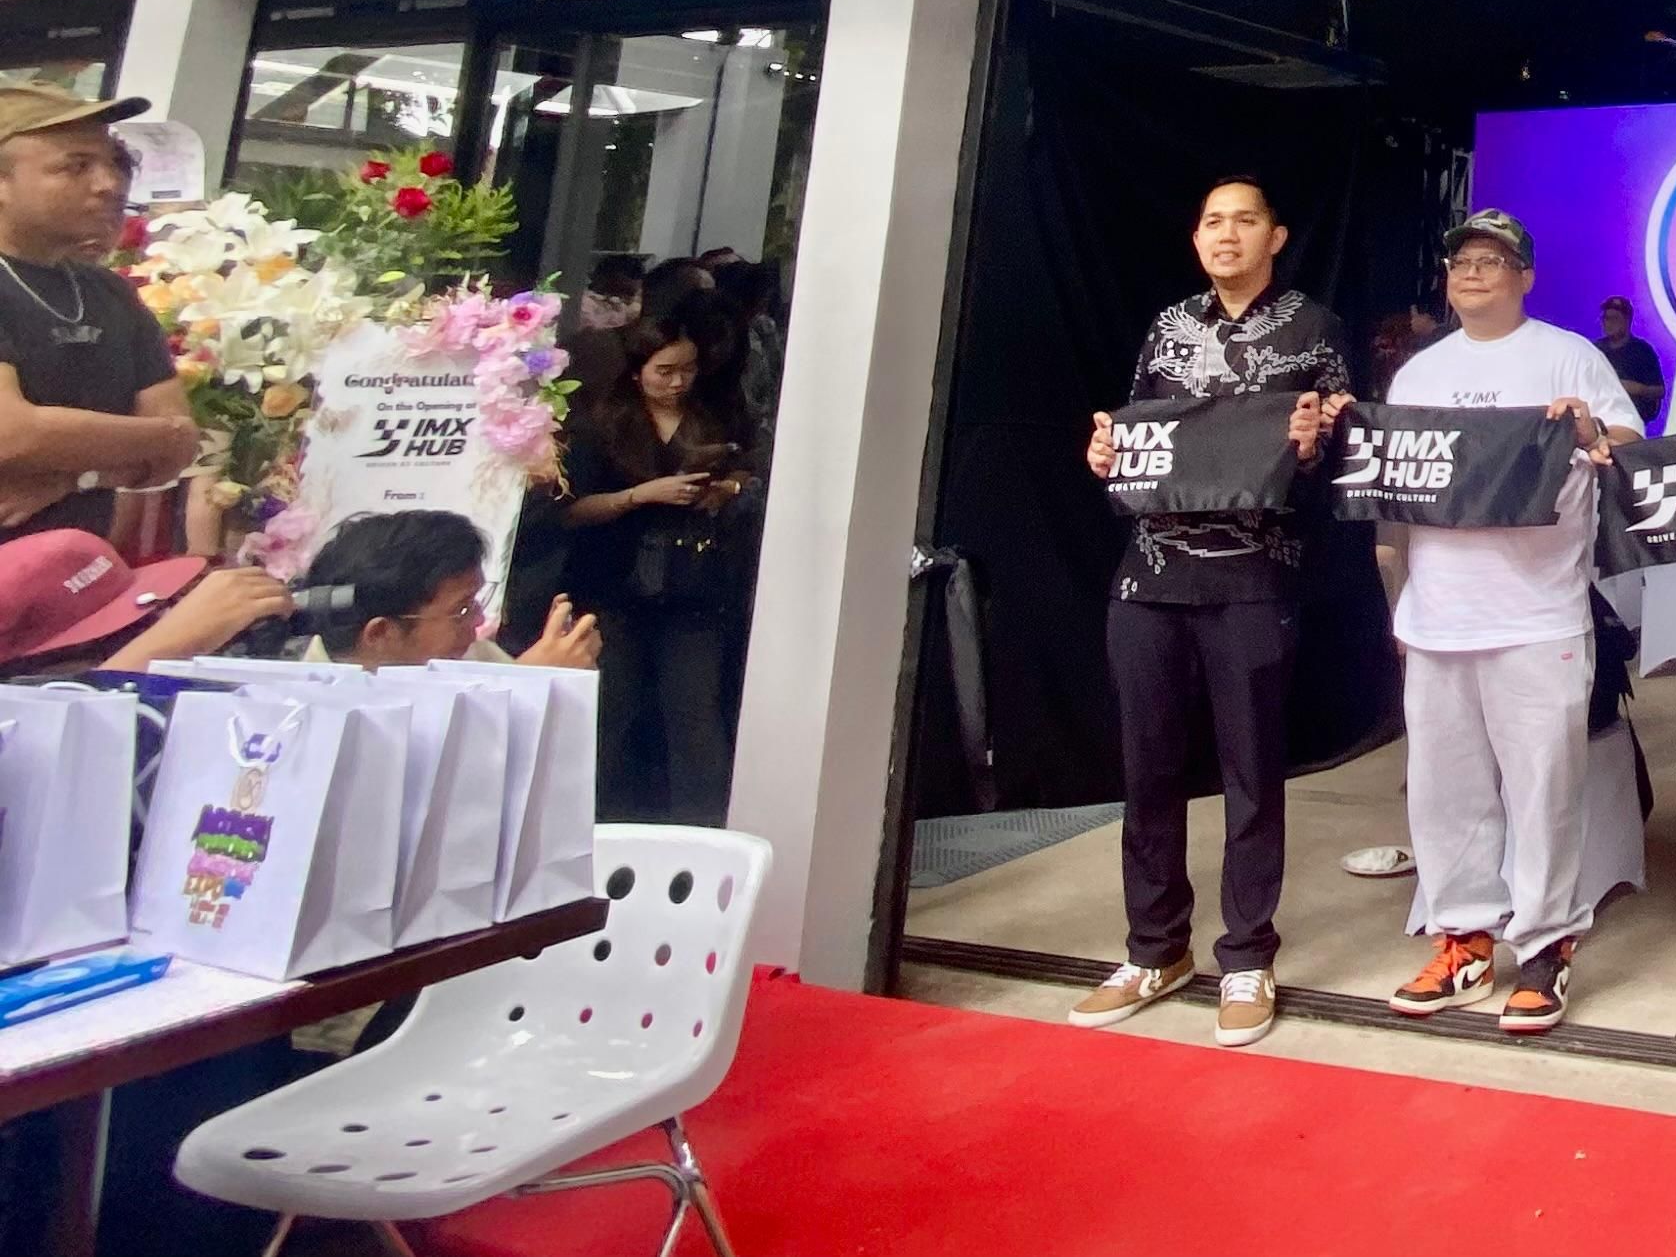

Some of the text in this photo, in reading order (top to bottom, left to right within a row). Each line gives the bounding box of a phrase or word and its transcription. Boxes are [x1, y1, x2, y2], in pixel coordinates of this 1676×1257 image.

[344, 373, 478, 395] Congratulat
[1472, 390, 1502, 404] IMX
[412, 417, 476, 437] IMX
[1112, 421, 1180, 449] MX
[403, 439, 467, 457] HUB
[1387, 430, 1462, 460] IMX
[1383, 460, 1454, 489] HUB
[1346, 489, 1383, 498] DRIVEN
[1396, 493, 1437, 503] CULTURE
